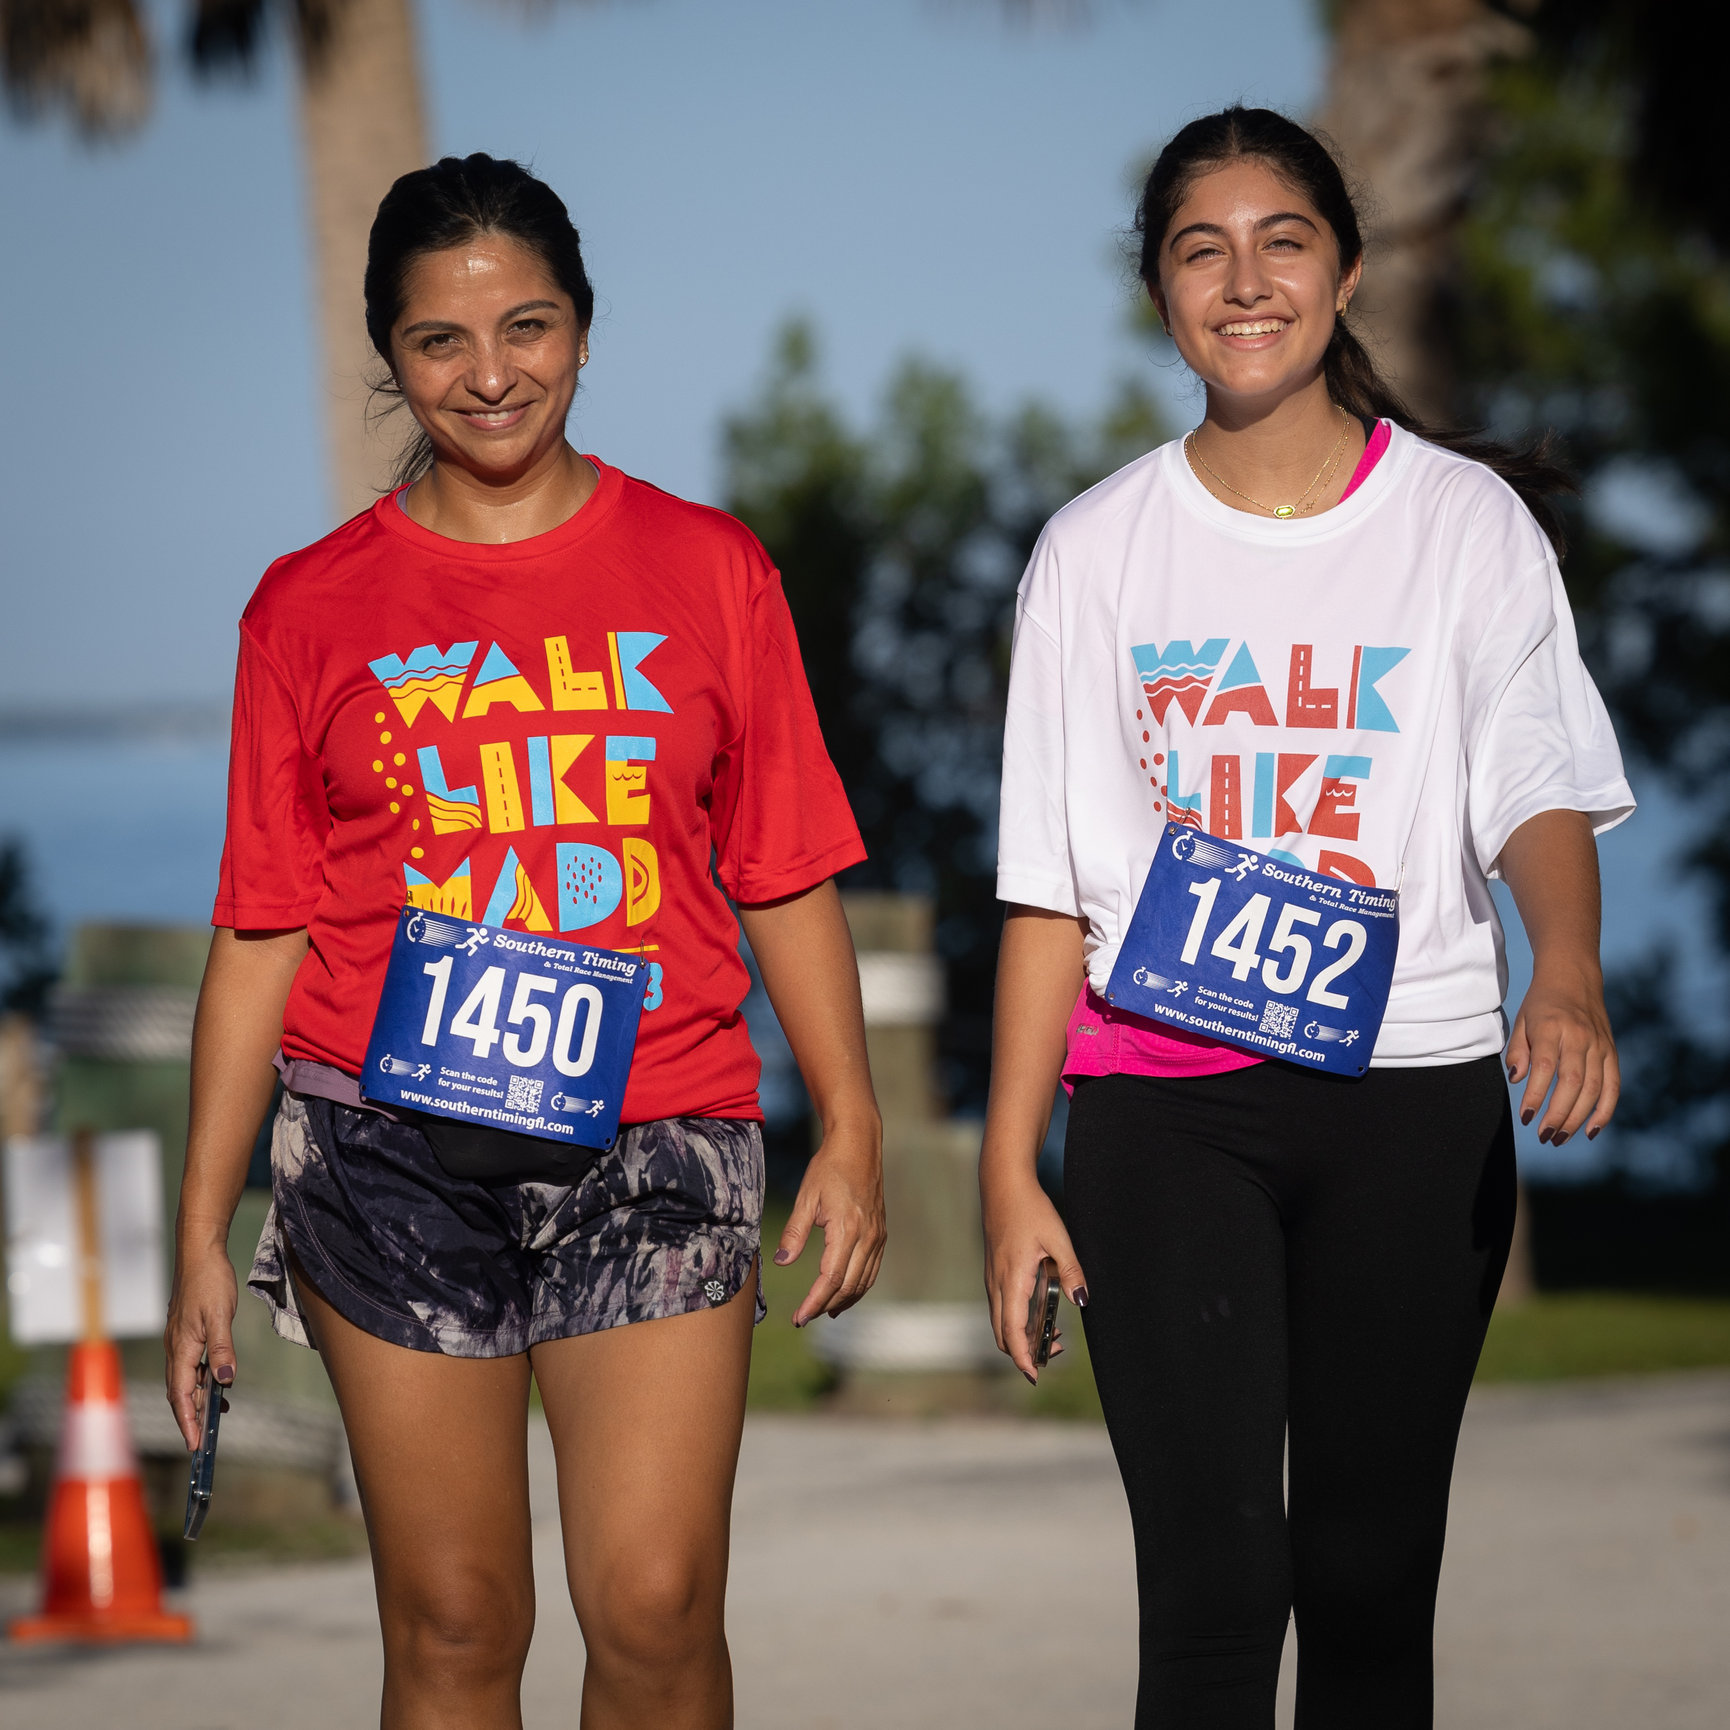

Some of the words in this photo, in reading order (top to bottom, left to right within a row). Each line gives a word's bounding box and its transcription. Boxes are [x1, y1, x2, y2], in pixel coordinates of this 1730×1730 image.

[367, 631, 675, 729] WALK
[1130, 638, 1412, 733] WALK
[416, 734, 657, 836] LIKE
[1166, 750, 1373, 841] LIKE
[403, 838, 661, 933] MADD
[1262, 863, 1341, 898] Southern
[1348, 888, 1396, 912] Timing
[1309, 894, 1317, 902] &
[1319, 898, 1338, 908] Total
[1339, 903, 1357, 913] Race
[1358, 908, 1395, 919] Management
[493, 934, 576, 962] Southern
[582, 950, 638, 977] Timing
[1180, 877, 1368, 1010] 1452
[553, 963, 574, 973] Total
[574, 966, 592, 976] Race
[592, 970, 634, 985] Management
[642, 962, 663, 1012] 3
[1198, 986, 1217, 998] Scan
[1218, 990, 1233, 1004] the
[1233, 996, 1255, 1010] code
[421, 955, 604, 1078] 1450
[1154, 1004, 1325, 1062] www.southerntimingfl.com
[1194, 996, 1209, 1007] for
[1208, 1000, 1227, 1013] your
[1228, 1007, 1259, 1022] results!
[437, 1077, 450, 1089] for
[451, 1081, 472, 1094] your
[472, 1085, 504, 1099] results!
[440, 1066, 460, 1079] Scan
[461, 1071, 476, 1082] the
[476, 1075, 498, 1086] code
[400, 1089, 574, 1135] www.southerntimingfl.com
